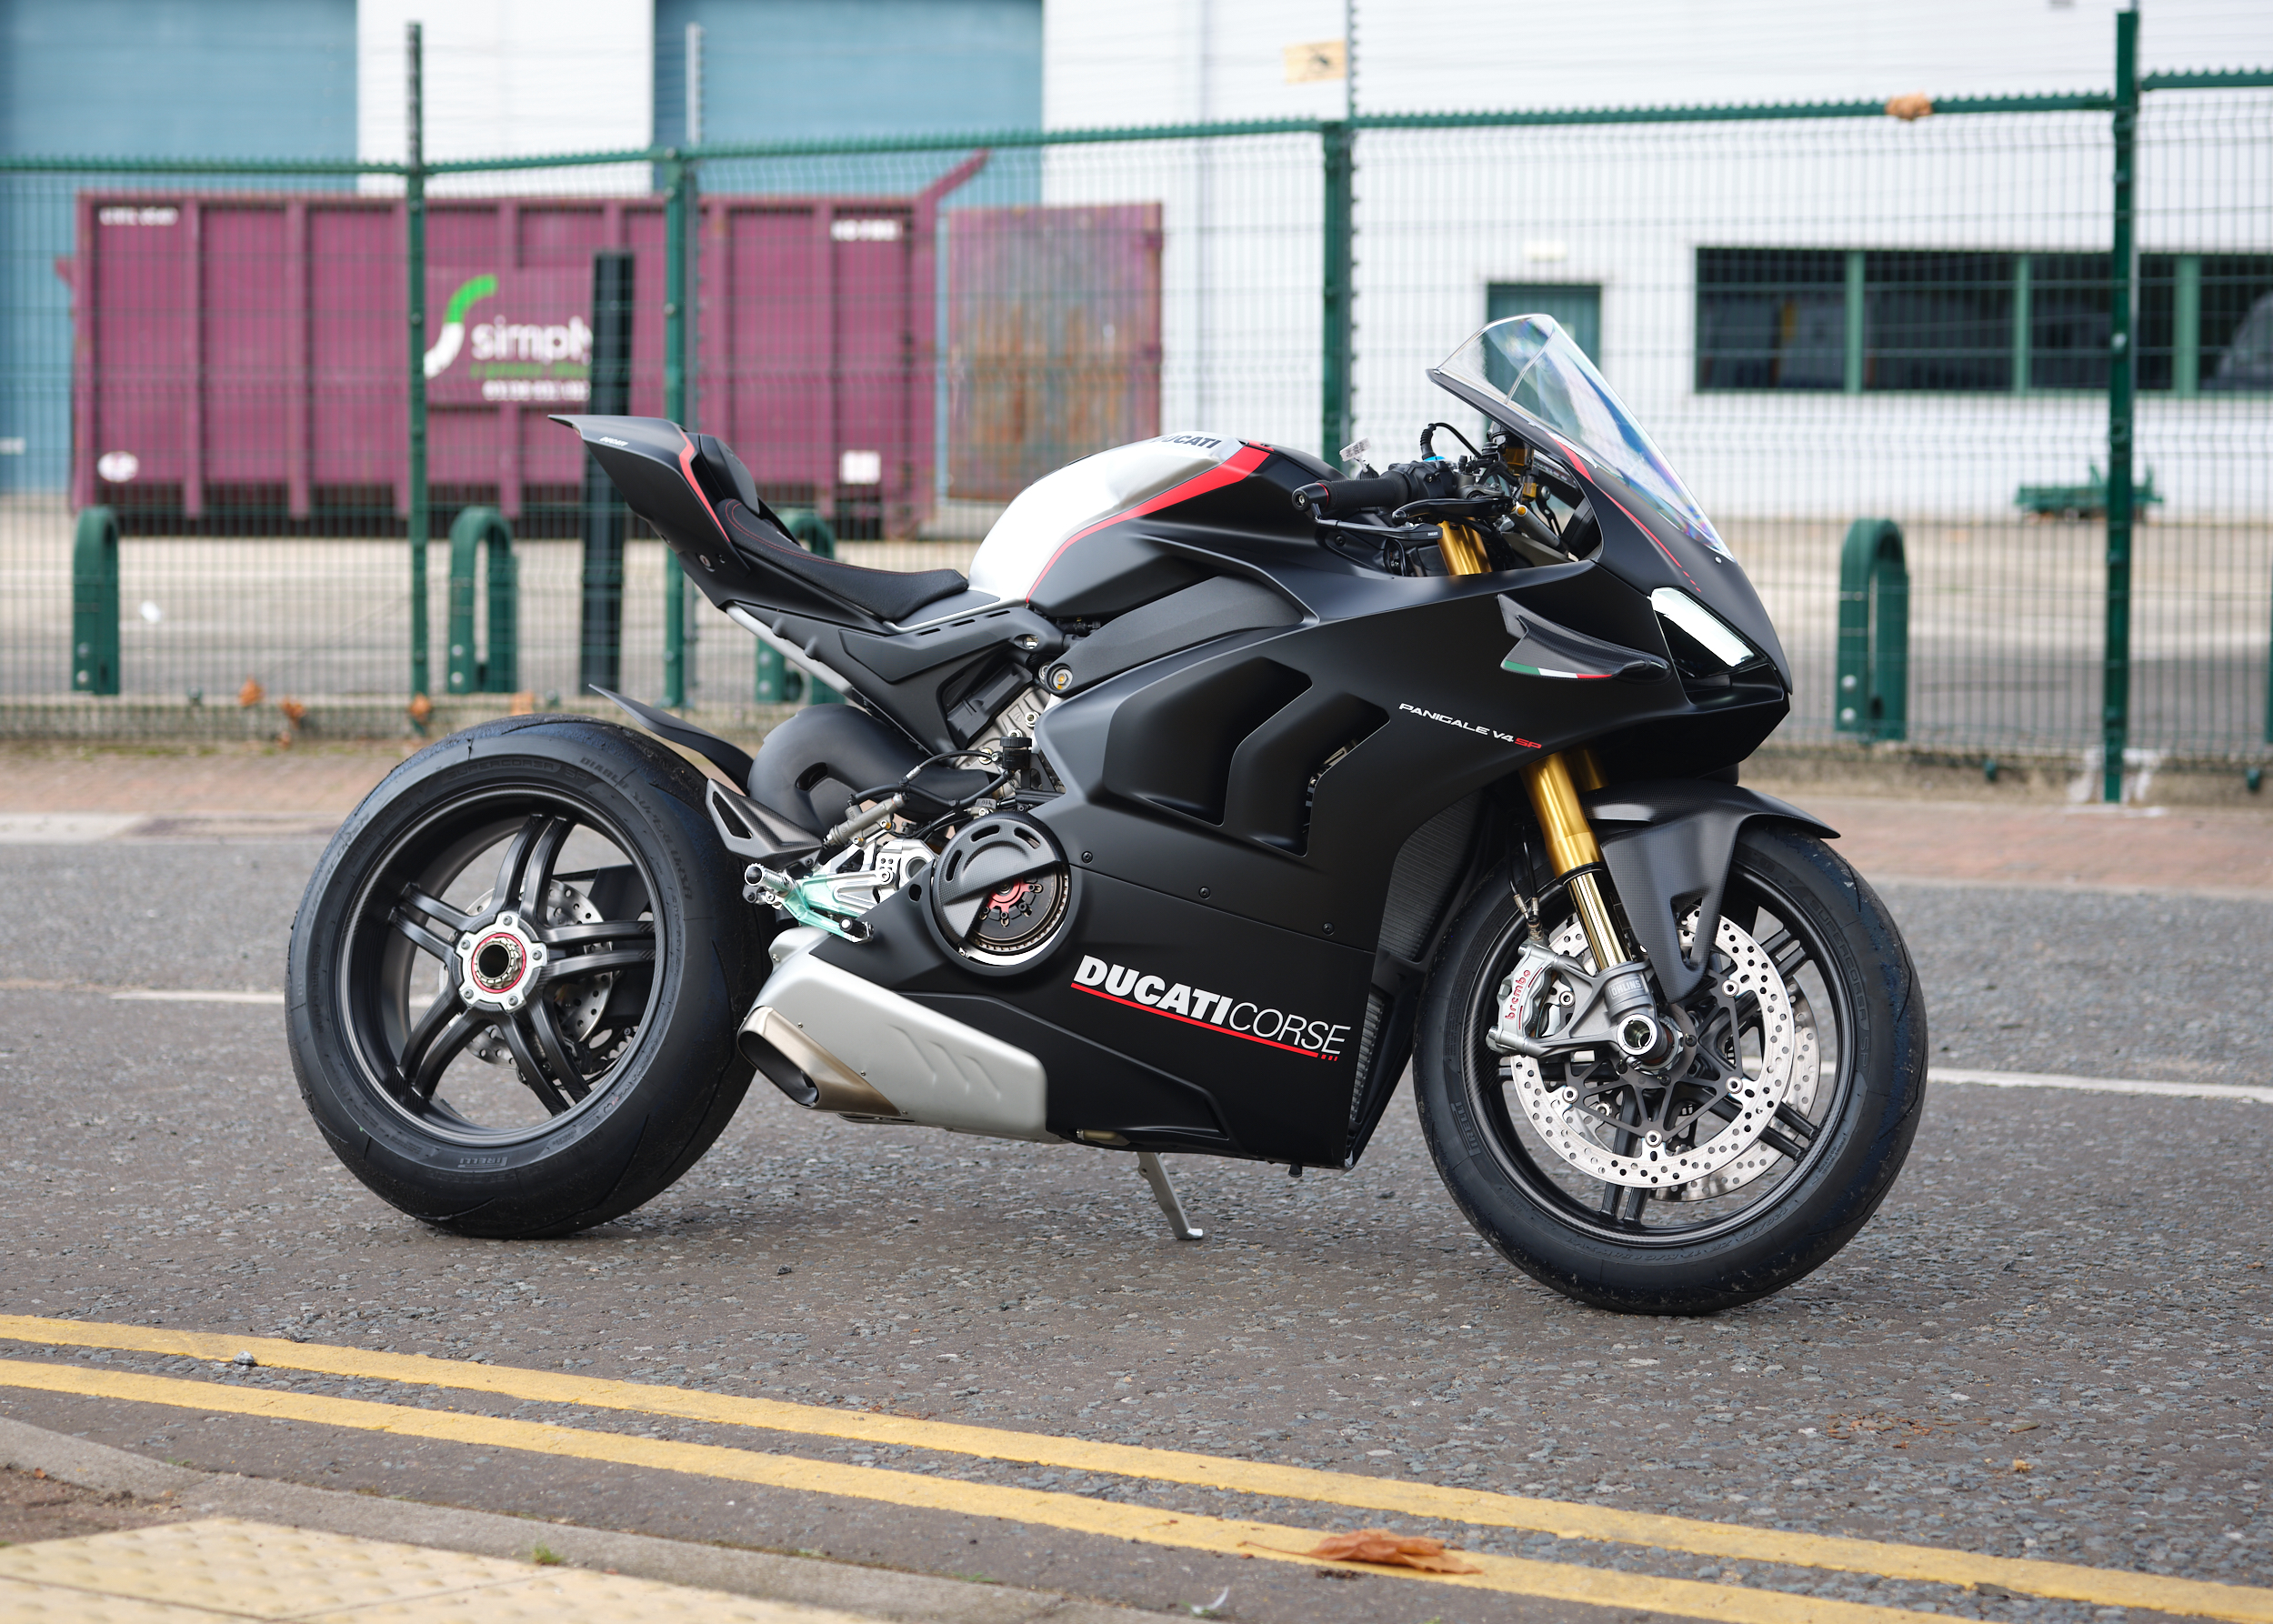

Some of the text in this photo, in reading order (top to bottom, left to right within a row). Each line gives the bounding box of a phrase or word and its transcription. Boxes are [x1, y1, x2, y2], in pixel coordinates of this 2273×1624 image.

[1398, 703, 1490, 735] PANIGALE
[1073, 955, 1234, 1026] DUCATI
[1505, 969, 1531, 1020] brembo
[1611, 978, 1642, 996] ÖHLINS
[1808, 898, 1869, 1069] SUPERCORSA SP
[1451, 1101, 1482, 1158] PIRELLI
[456, 1156, 508, 1168] PIRELLI
